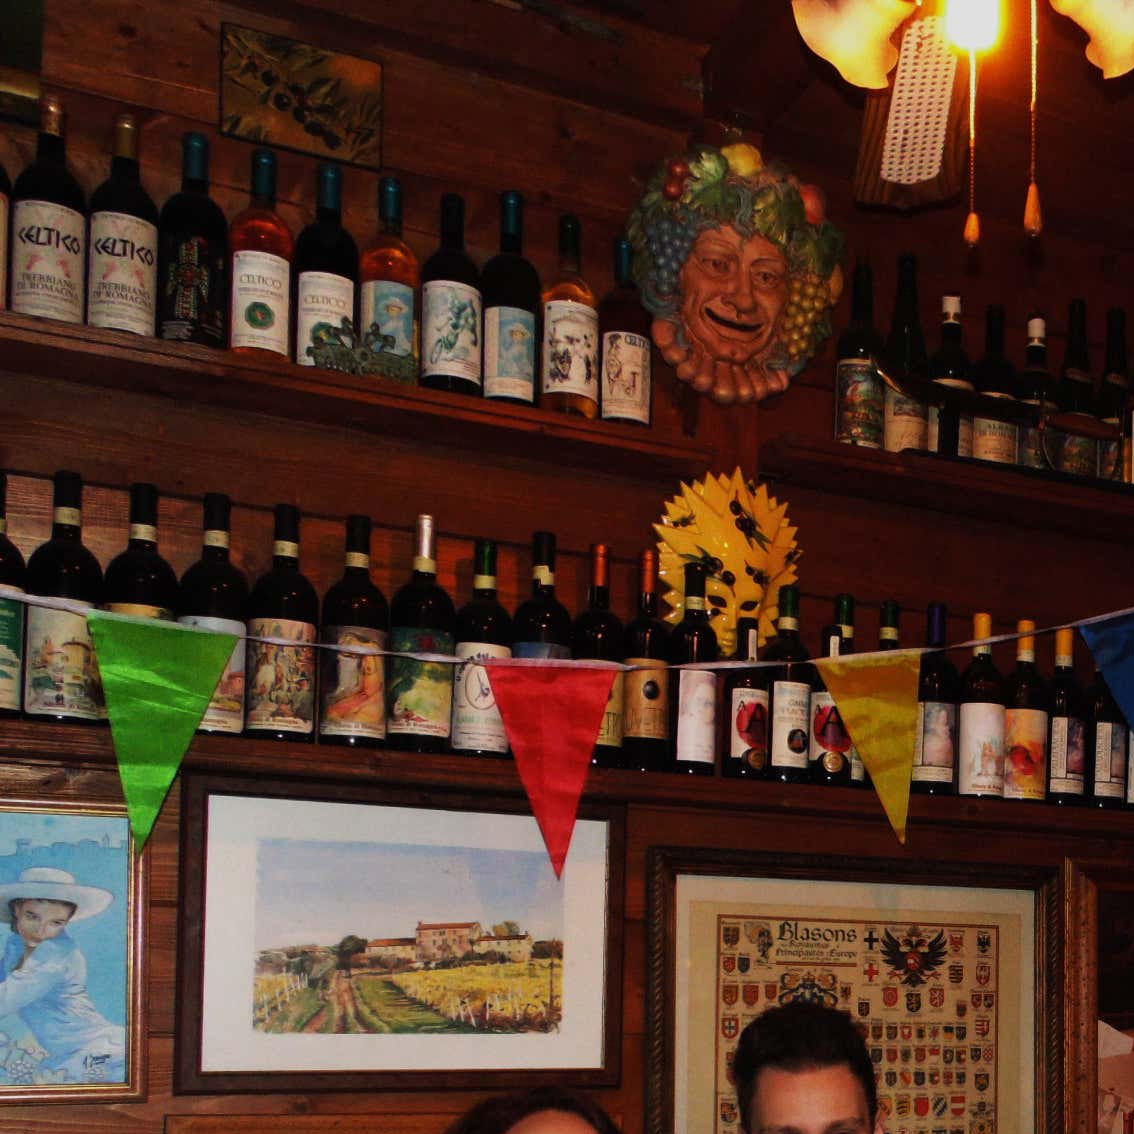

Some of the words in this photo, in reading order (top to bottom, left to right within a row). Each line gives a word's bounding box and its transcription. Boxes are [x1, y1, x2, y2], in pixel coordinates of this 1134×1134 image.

[17, 225, 81, 256] CELTICO
[94, 236, 155, 266] CELTICO
[776, 920, 858, 943] Blasons
